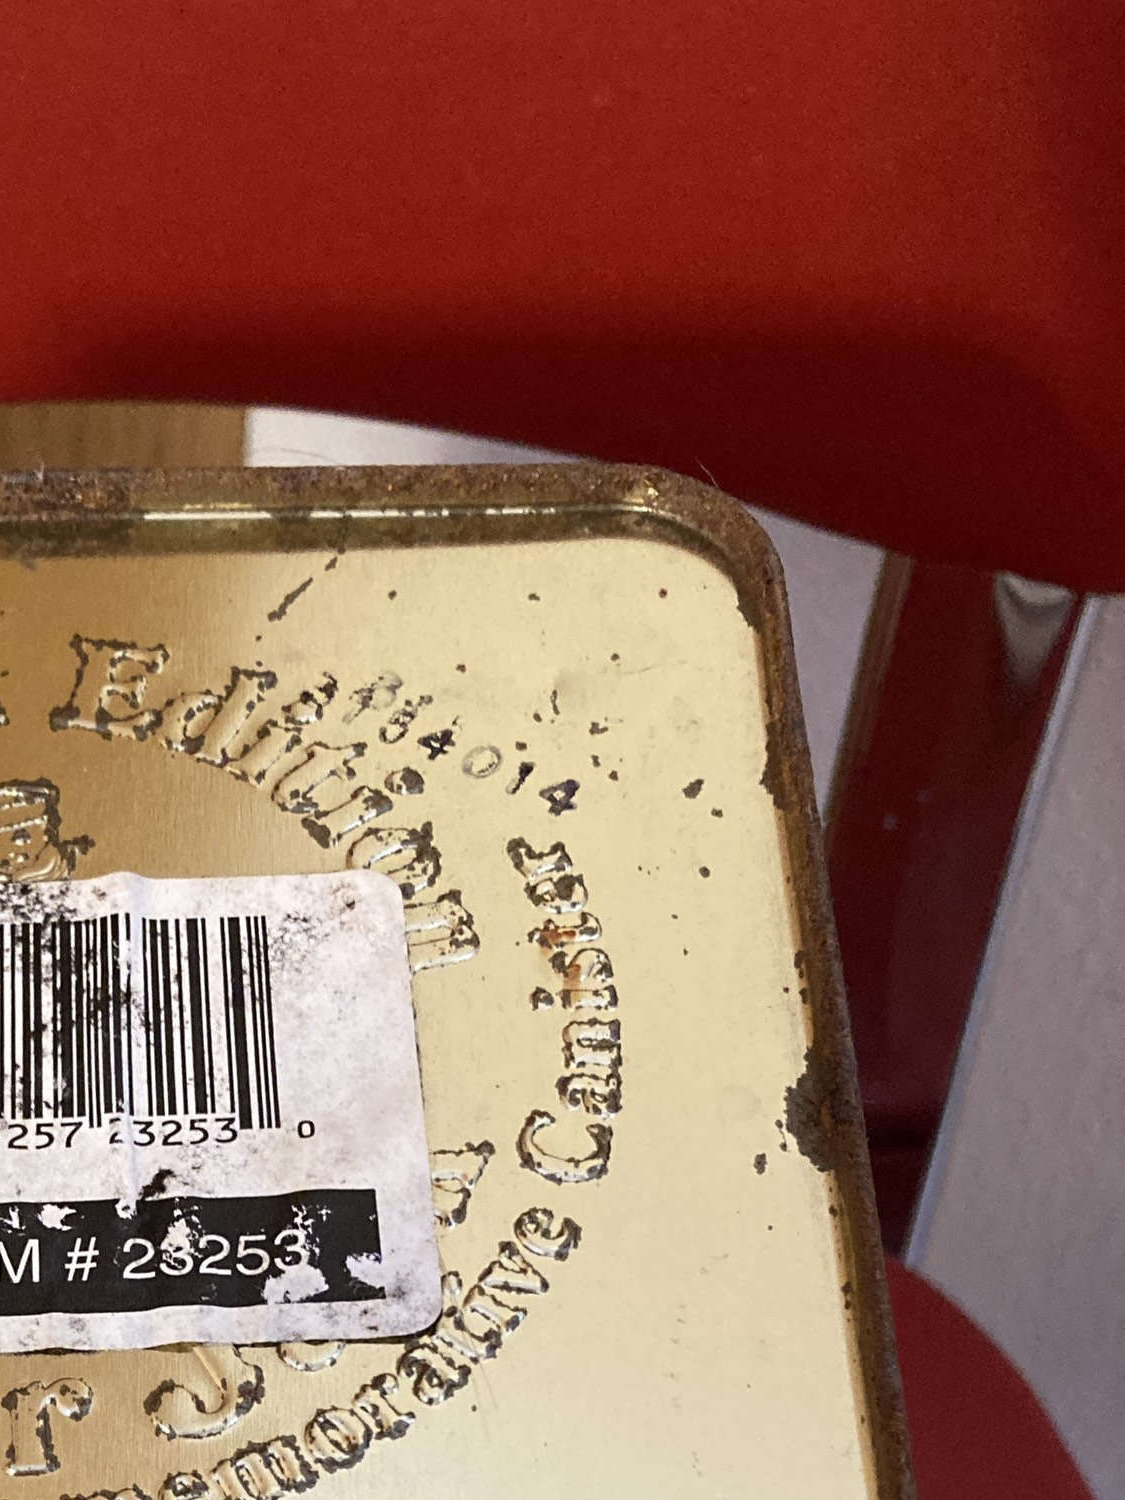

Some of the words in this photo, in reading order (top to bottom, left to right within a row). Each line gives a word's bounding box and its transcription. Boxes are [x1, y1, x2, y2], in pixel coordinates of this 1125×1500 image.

[49, 633, 479, 972] Edition
[507, 836, 623, 1185] Canister
[297, 1119, 316, 1140] 0
[64, 1236, 100, 1282] #
